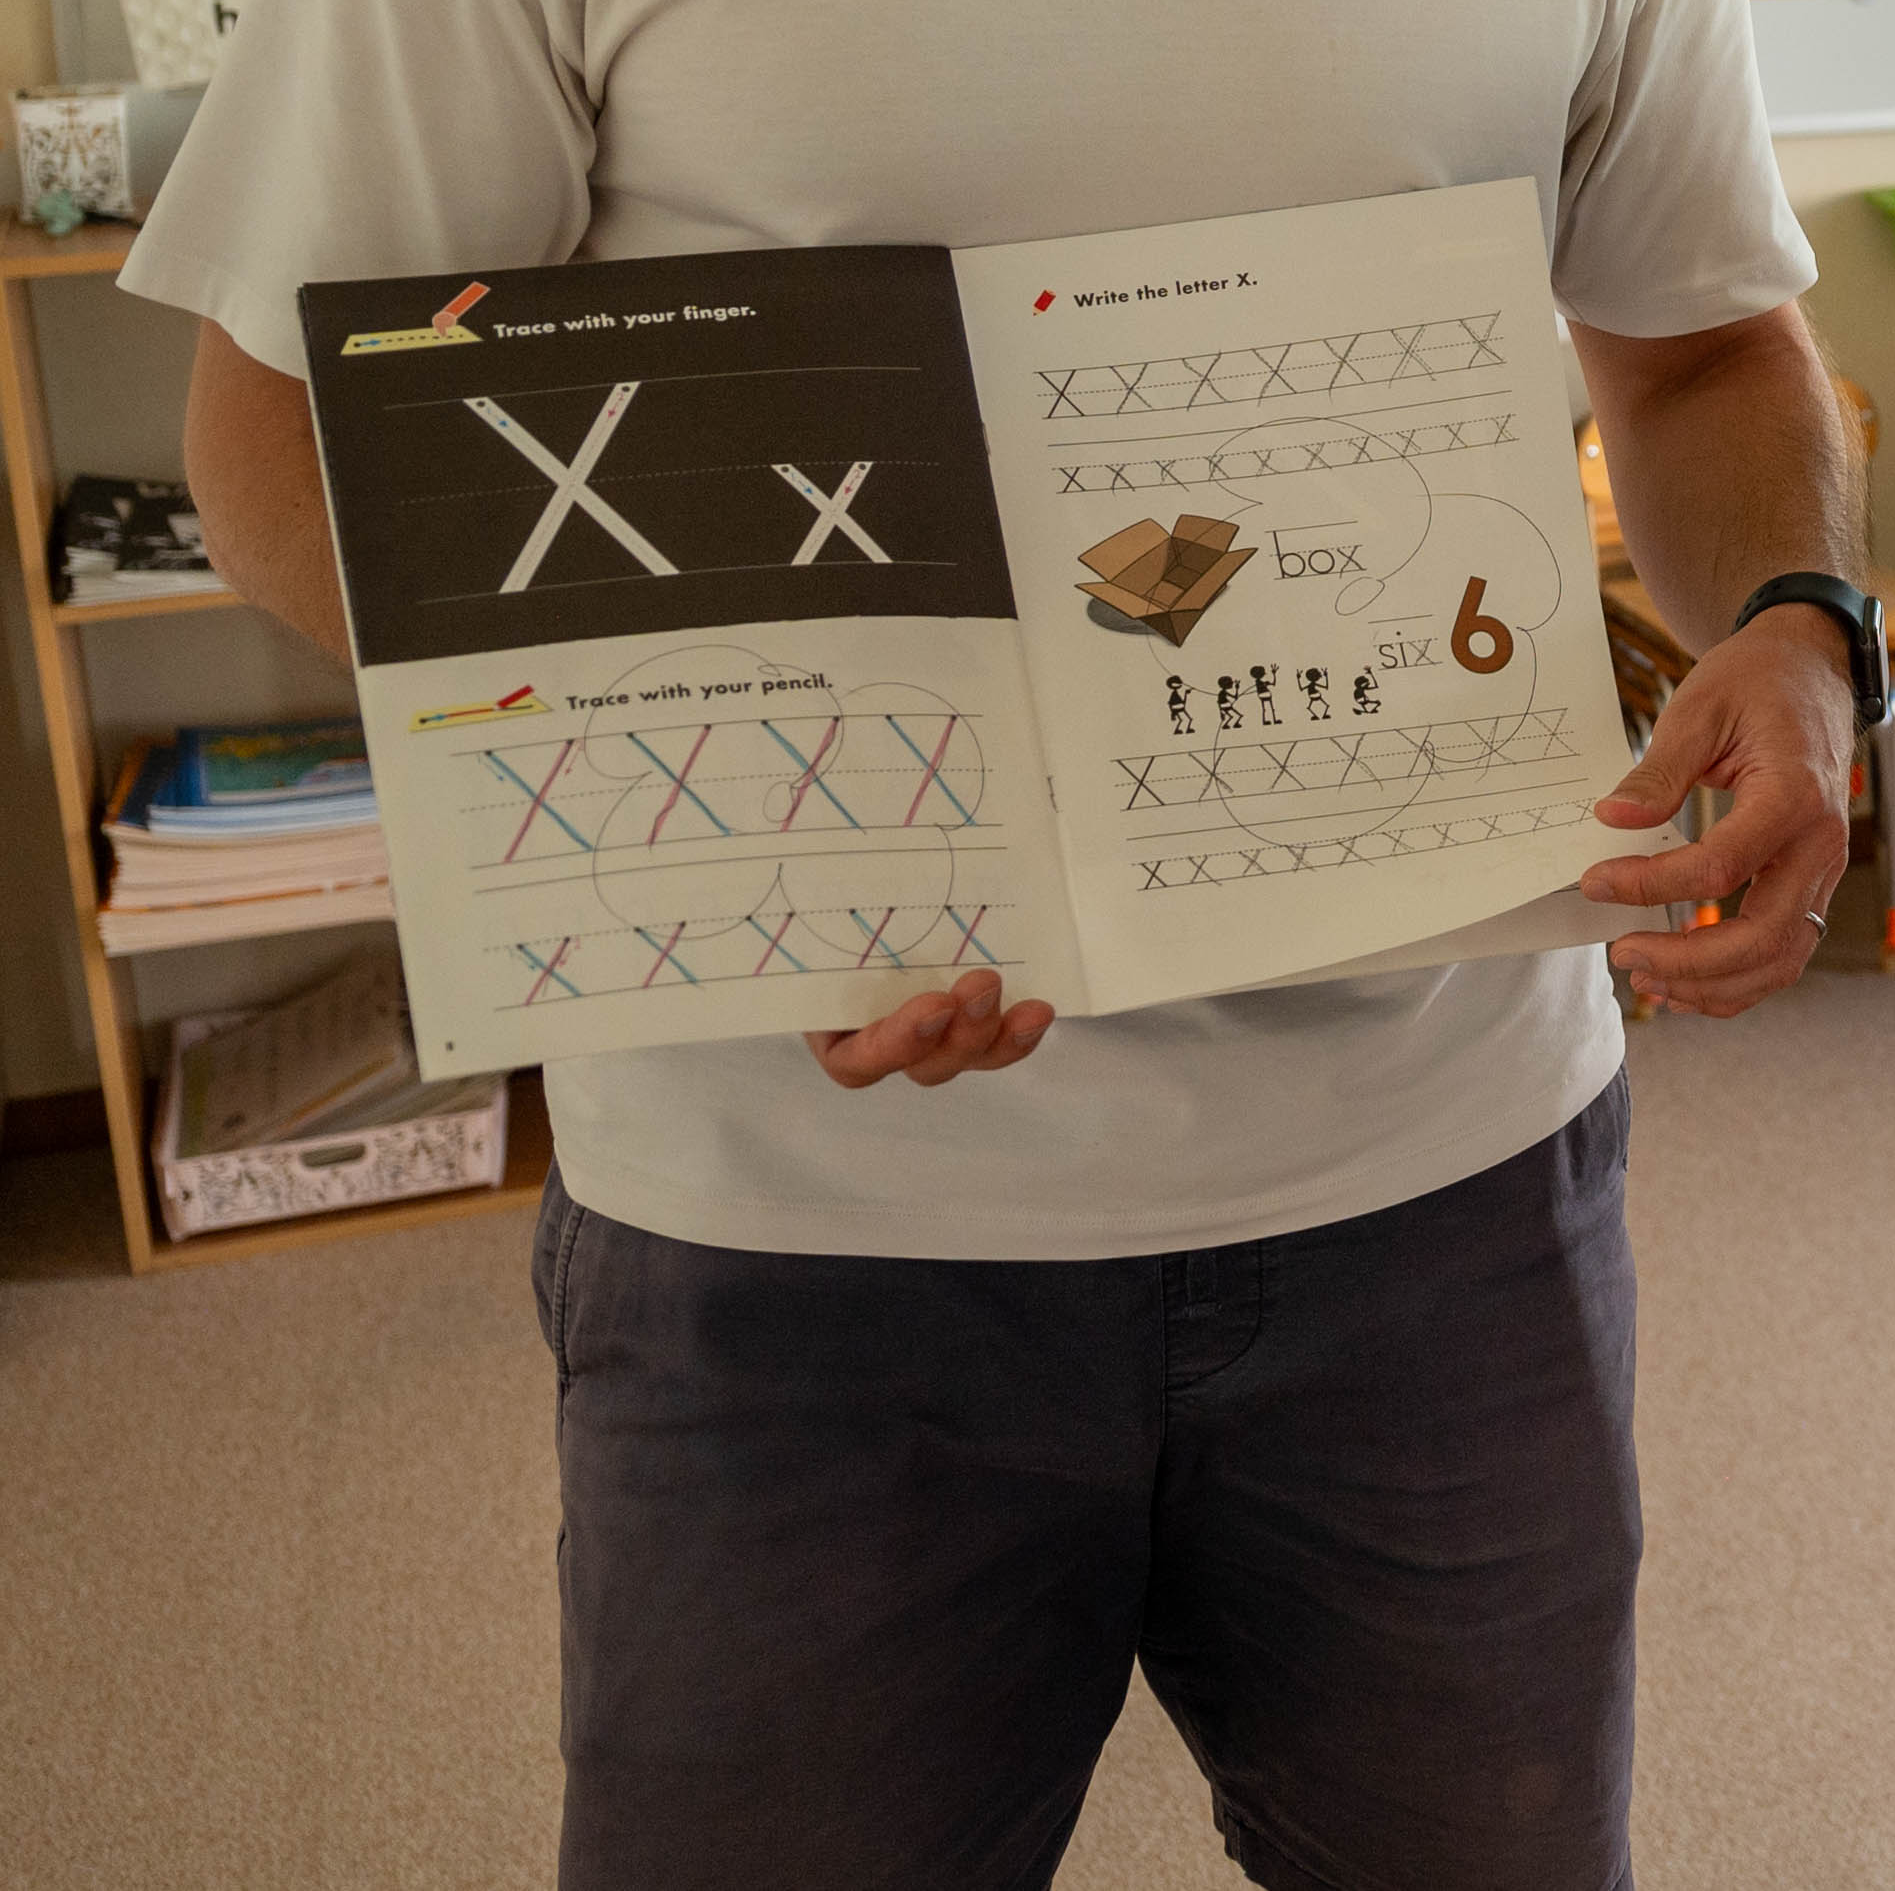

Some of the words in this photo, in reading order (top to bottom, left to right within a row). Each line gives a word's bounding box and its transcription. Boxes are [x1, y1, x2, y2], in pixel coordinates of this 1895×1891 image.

[1073, 288, 1130, 309] Write
[1136, 281, 1169, 302] the
[1175, 275, 1230, 296] letter
[1236, 270, 1258, 288] X.
[493, 318, 557, 339] Trace
[564, 310, 616, 331] with
[625, 306, 678, 331] your
[683, 302, 757, 329] finger.
[461, 381, 681, 594] X
[771, 461, 894, 566] x
[1273, 531, 1367, 578] box
[1451, 576, 1514, 673] 6
[1377, 629, 1436, 669] six
[566, 693, 631, 712] Trace
[638, 682, 692, 704] with
[700, 678, 753, 702] your
[761, 672, 834, 699] pencil.
